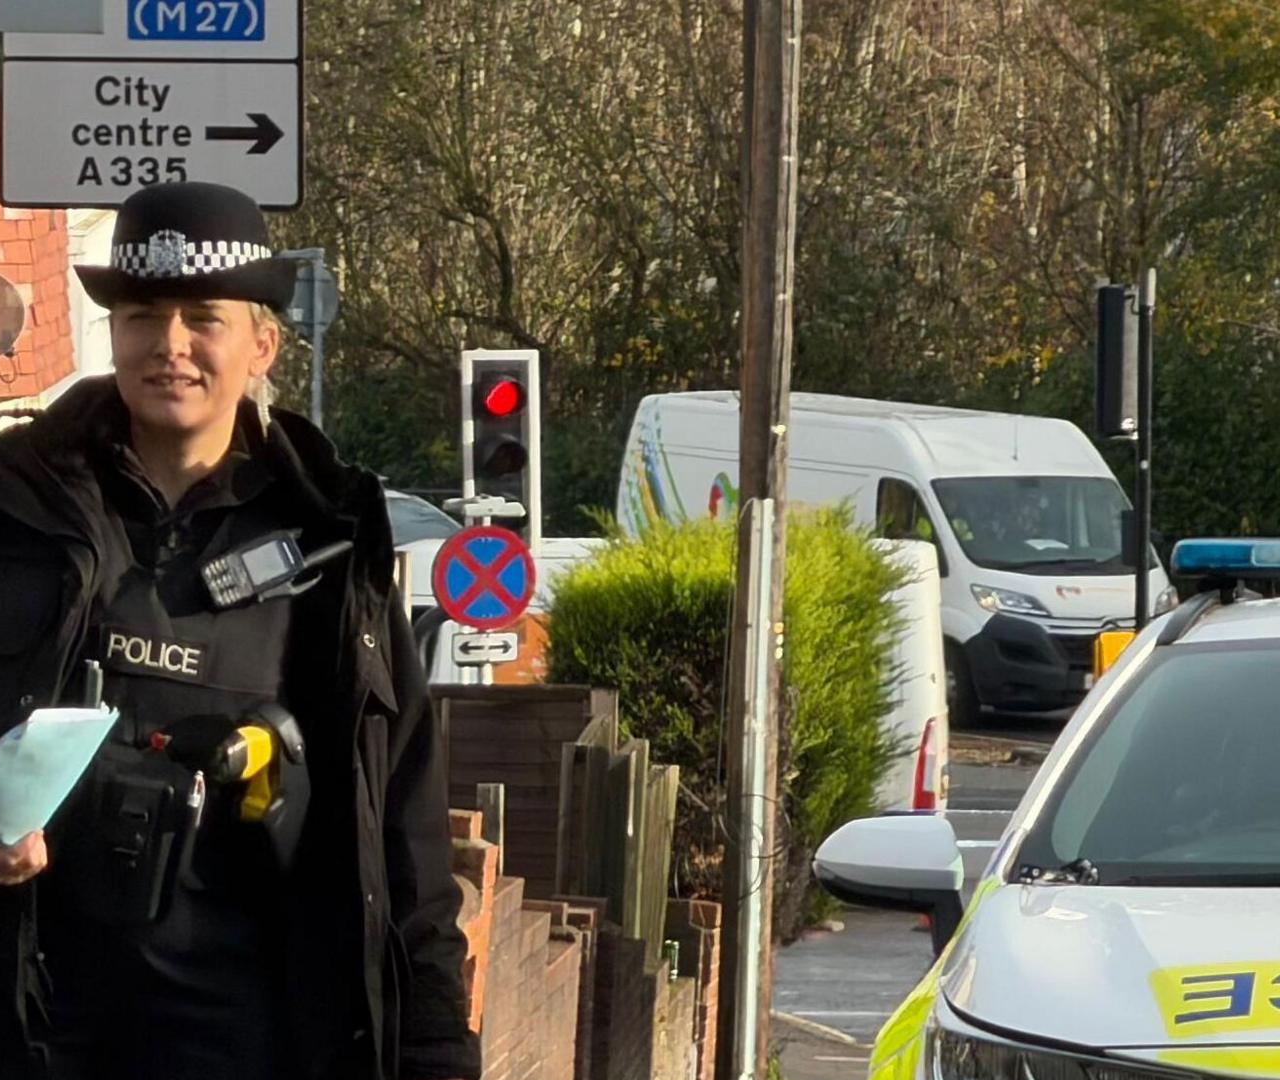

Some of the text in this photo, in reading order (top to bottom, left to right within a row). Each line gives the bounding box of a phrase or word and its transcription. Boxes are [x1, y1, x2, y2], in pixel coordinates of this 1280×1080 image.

[95, 75, 171, 112] City
[71, 117, 192, 147] centre
[77, 156, 187, 187] A335
[107, 633, 201, 675] POLICE
